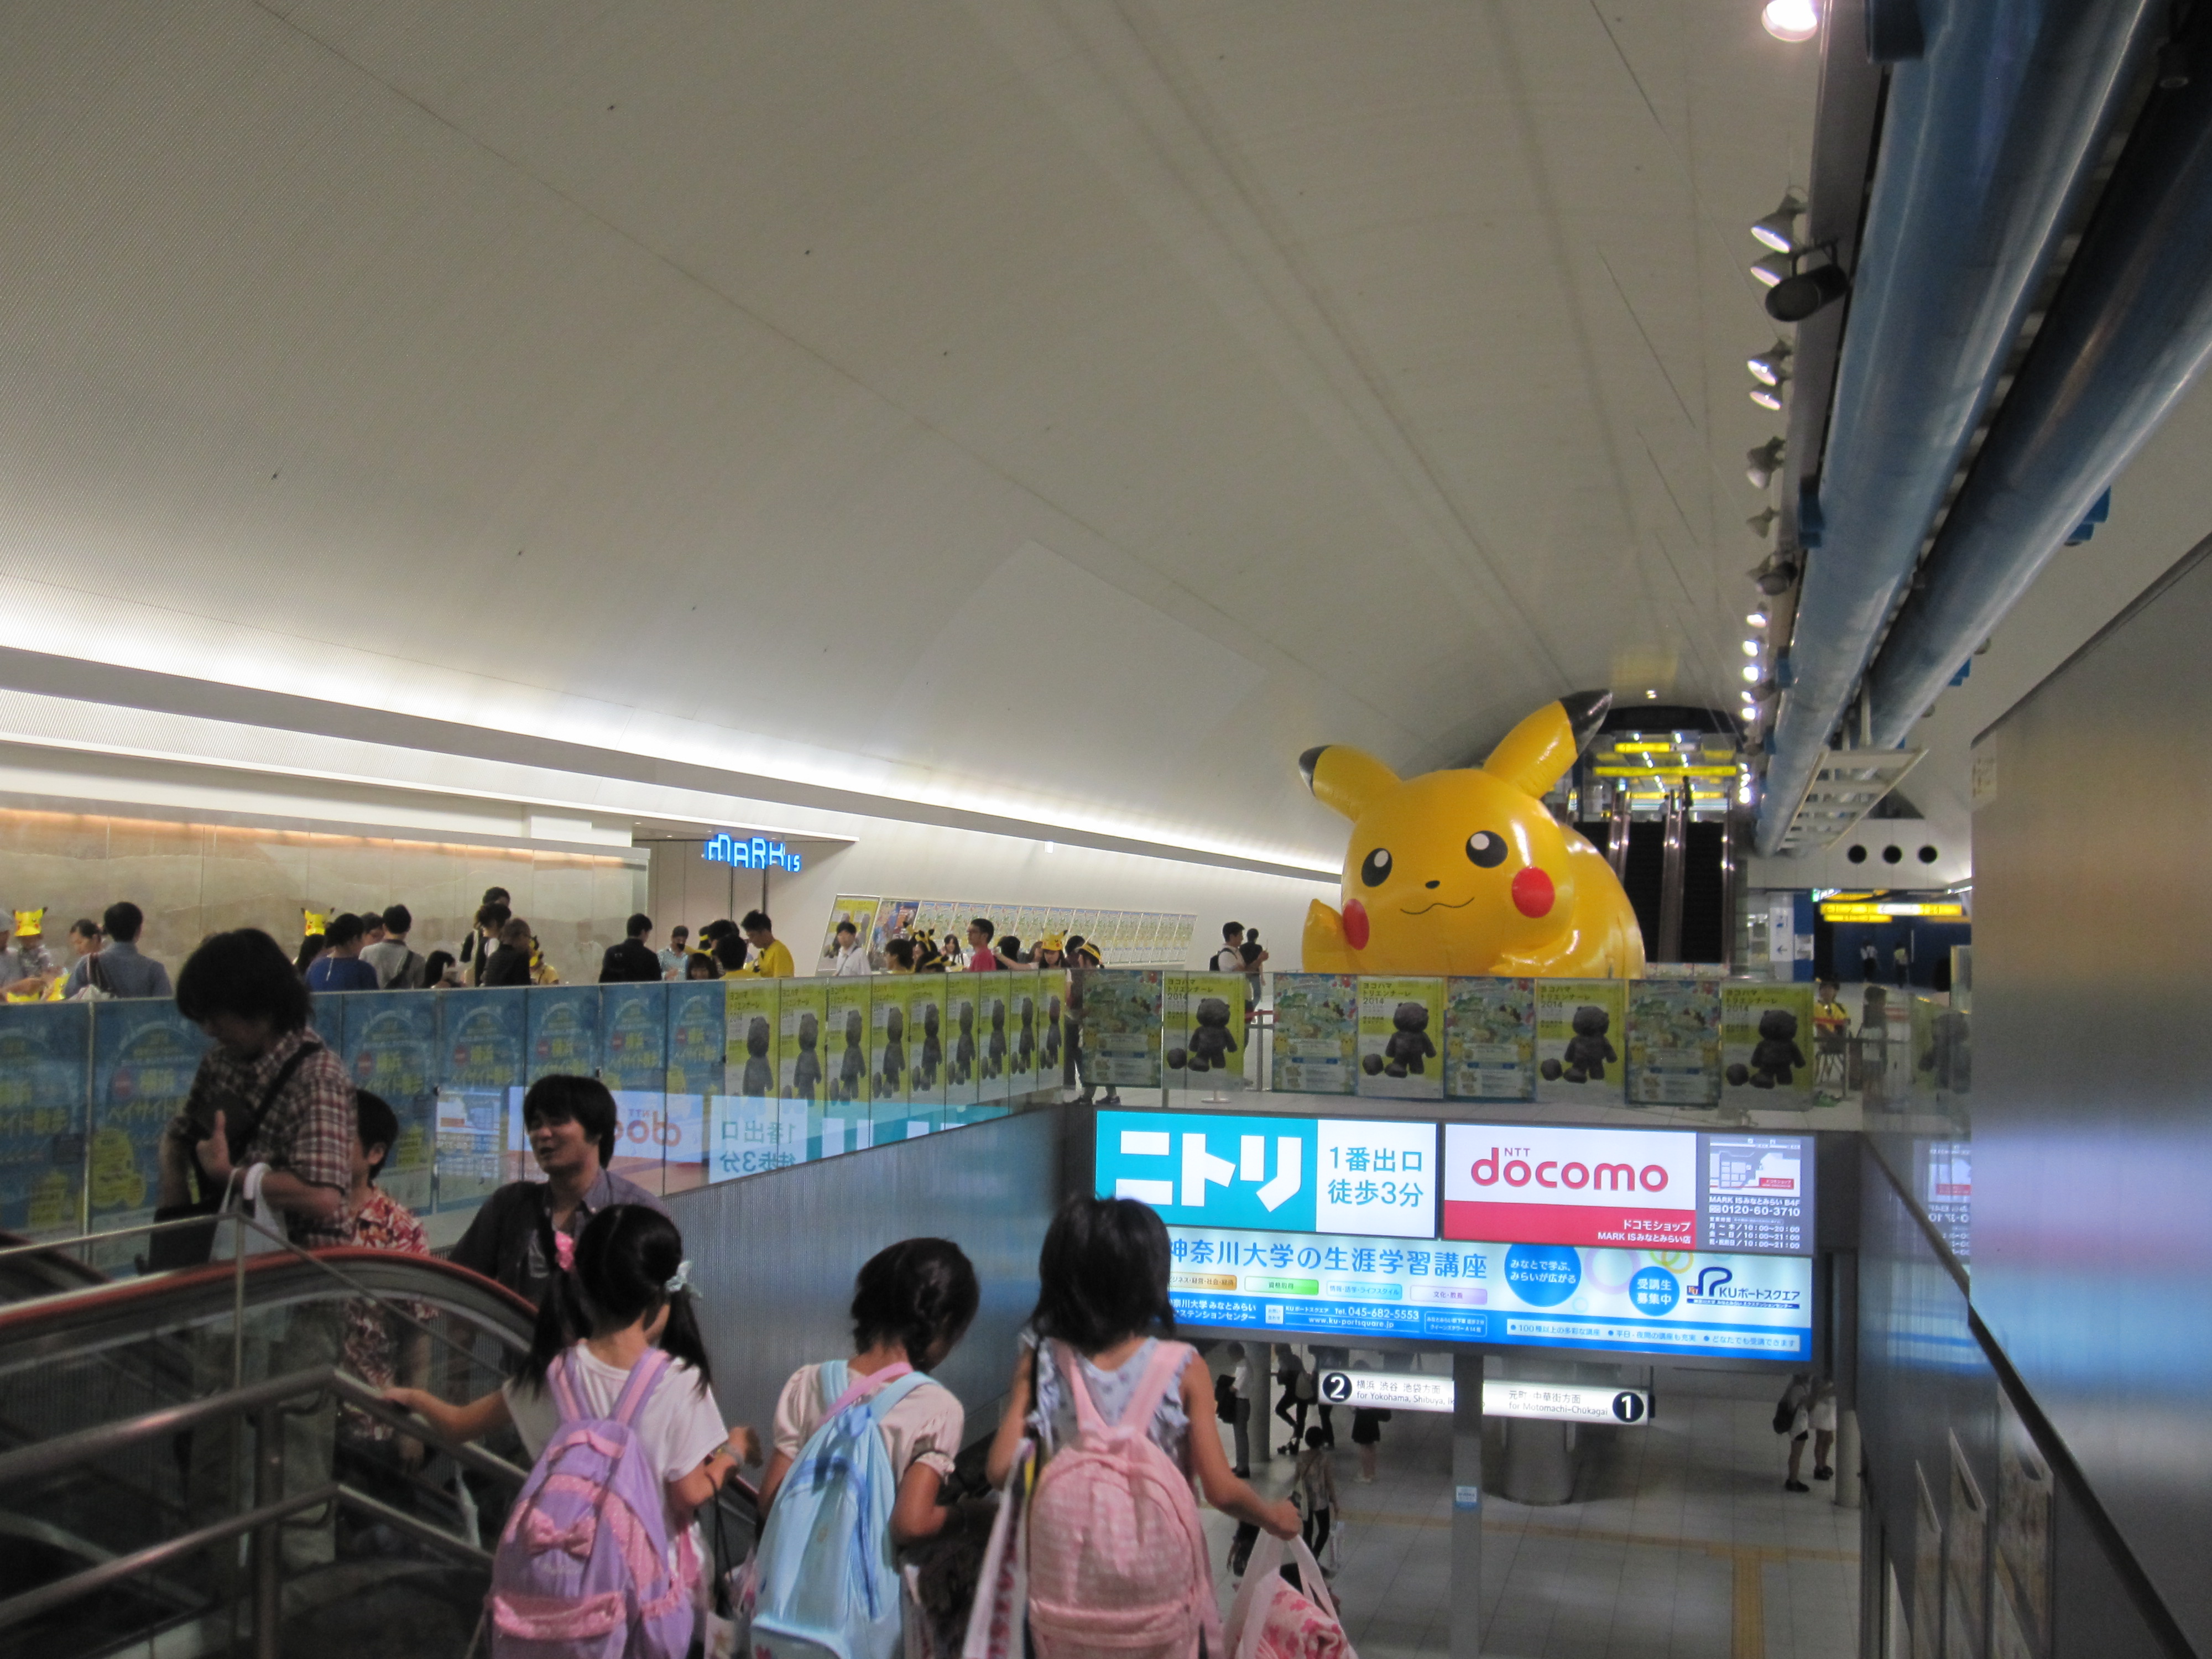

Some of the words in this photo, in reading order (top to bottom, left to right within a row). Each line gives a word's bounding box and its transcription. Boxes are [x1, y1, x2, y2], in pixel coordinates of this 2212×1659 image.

[708, 833, 786, 869] MARK
[787, 854, 801, 872] IS
[1504, 1147, 1531, 1157] NTT
[1330, 1146, 1422, 1173] 1番出口
[1115, 1130, 1302, 1212] ニトリ
[1471, 1147, 1668, 1193] docomo
[1328, 1178, 1424, 1208] 徒歩3分
[1721, 1204, 1801, 1217] 0120-60-3710
[1623, 1219, 1691, 1232] ドコモショップ
[1598, 1232, 1625, 1241] MARK
[1170, 1238, 1487, 1279] 神奈川大学の生涯学習講座
[1510, 1271, 1576, 1285] みらいが広がる
[1637, 1277, 1672, 1291] 受講生
[1637, 1292, 1672, 1306] 募集中
[1719, 1286, 1801, 1301] KUポートスクエア
[1348, 1307, 1420, 1320] 045-682-5553
[1308, 1317, 1394, 1328] www.ku-portsquare.jp
[1330, 1376, 1345, 1399] 2
[1357, 1379, 1375, 1389] 横浜
[1380, 1381, 1398, 1391] 渋谷
[1403, 1383, 1441, 1394] 池袋方面
[1370, 1392, 1411, 1403] Yokohama,
[1413, 1396, 1446, 1406] Shibuya,
[1509, 1401, 1520, 1410] for
[1621, 1395, 1632, 1420] 1
